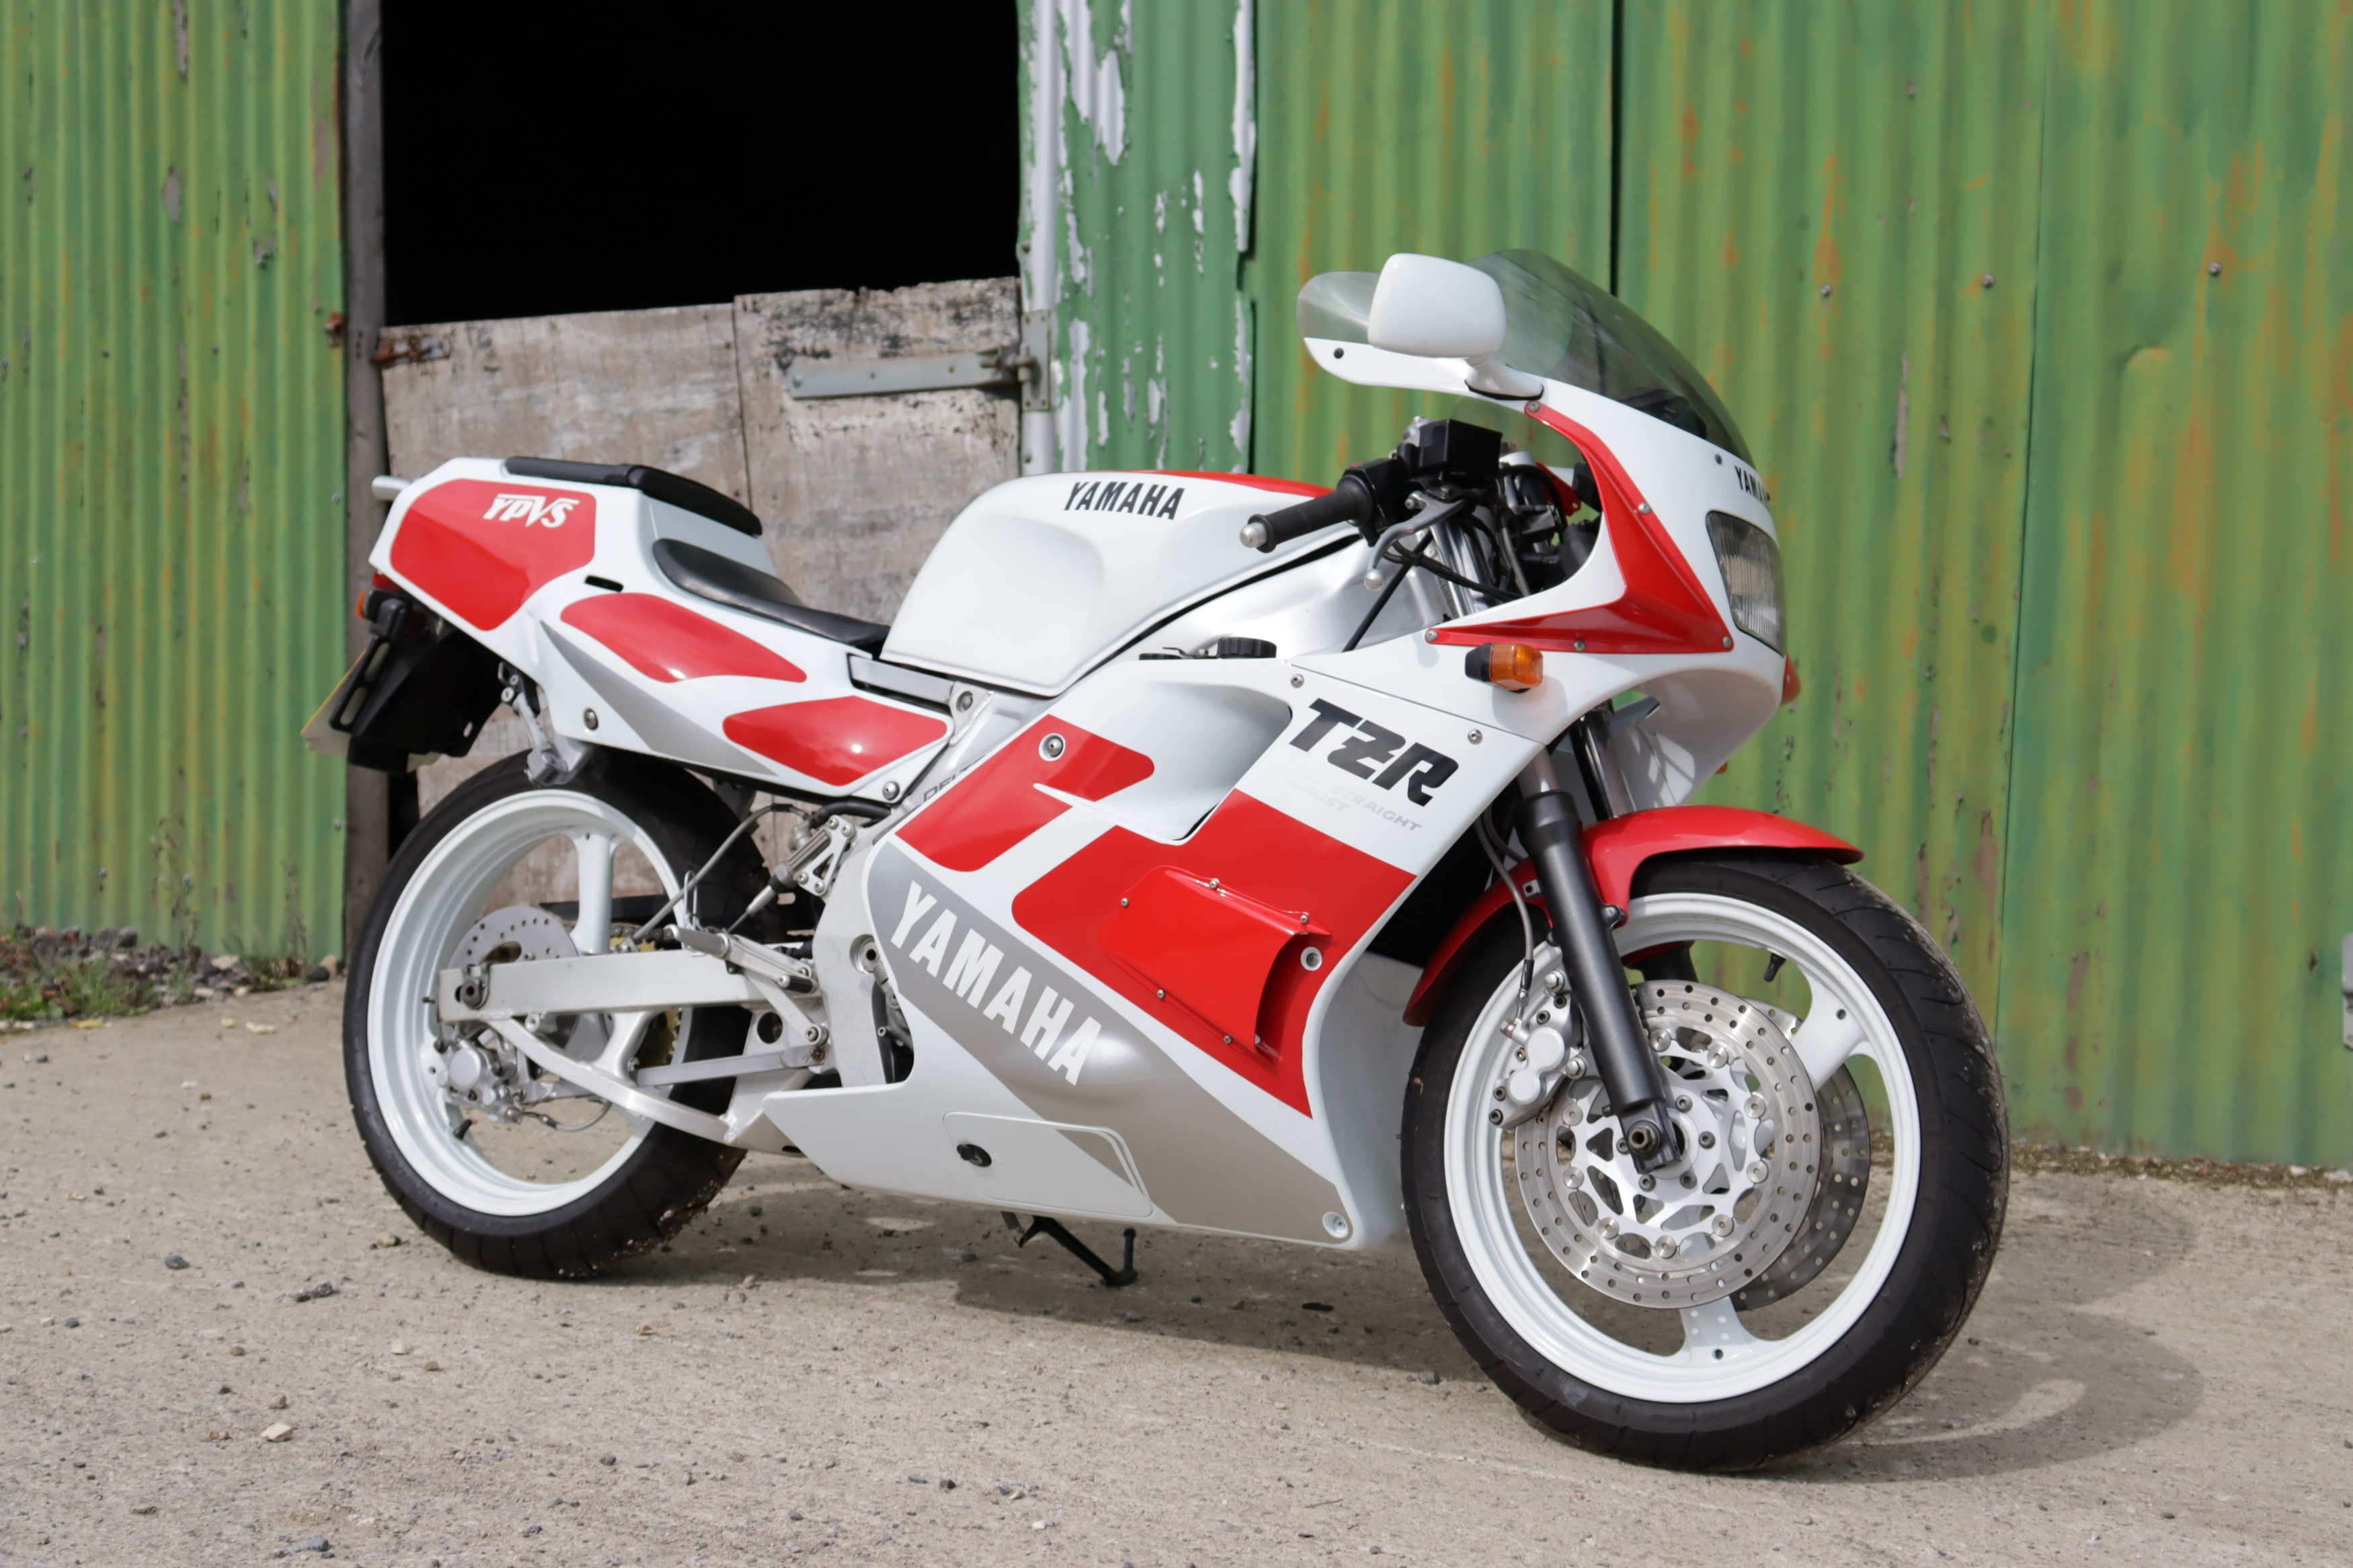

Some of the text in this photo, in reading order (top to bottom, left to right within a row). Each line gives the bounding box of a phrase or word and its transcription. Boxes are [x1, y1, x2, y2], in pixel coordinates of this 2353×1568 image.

[483, 493, 580, 528] YPVS
[1064, 481, 1185, 520] YAMAHA
[1289, 698, 1459, 807] TZR
[1328, 782, 1422, 831] STRAIGHT
[891, 880, 1102, 1086] YAMAHA
